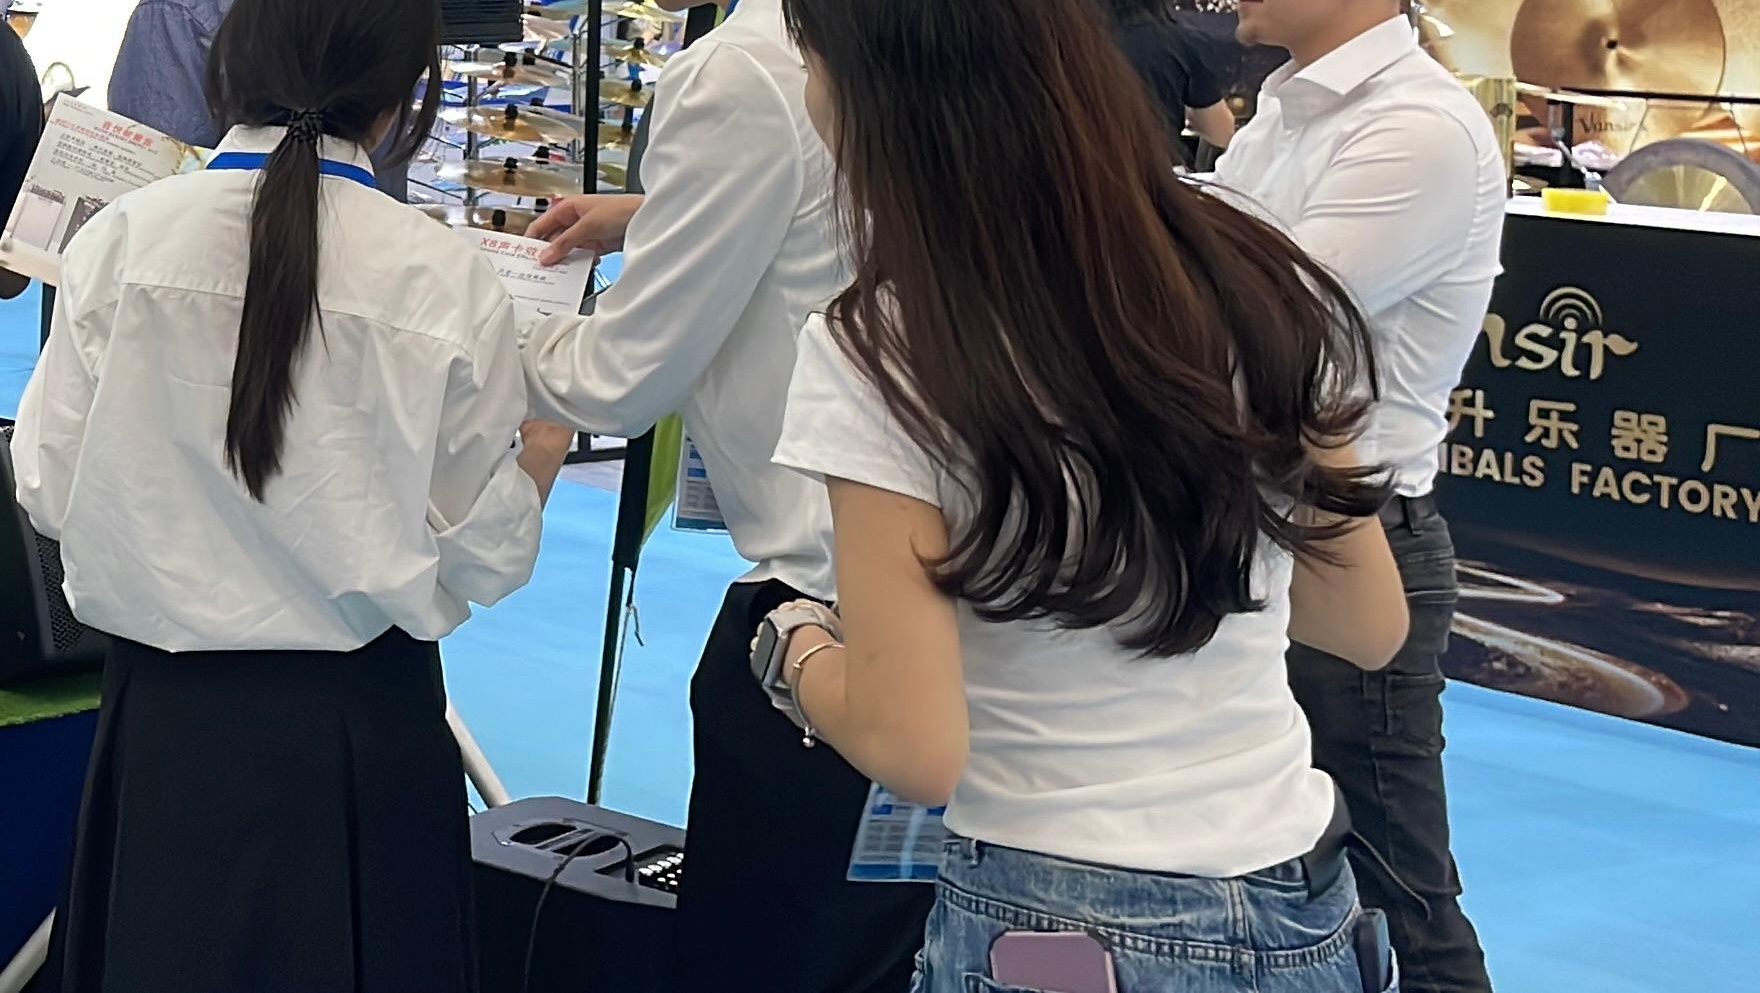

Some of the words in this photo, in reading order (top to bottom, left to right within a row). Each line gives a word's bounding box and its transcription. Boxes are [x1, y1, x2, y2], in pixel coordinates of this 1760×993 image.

[1481, 313, 1638, 380] nsir
[1446, 388, 1760, 473] 升乐器厂
[1439, 442, 1545, 488] BALS
[1571, 463, 1760, 523] FACTORY
